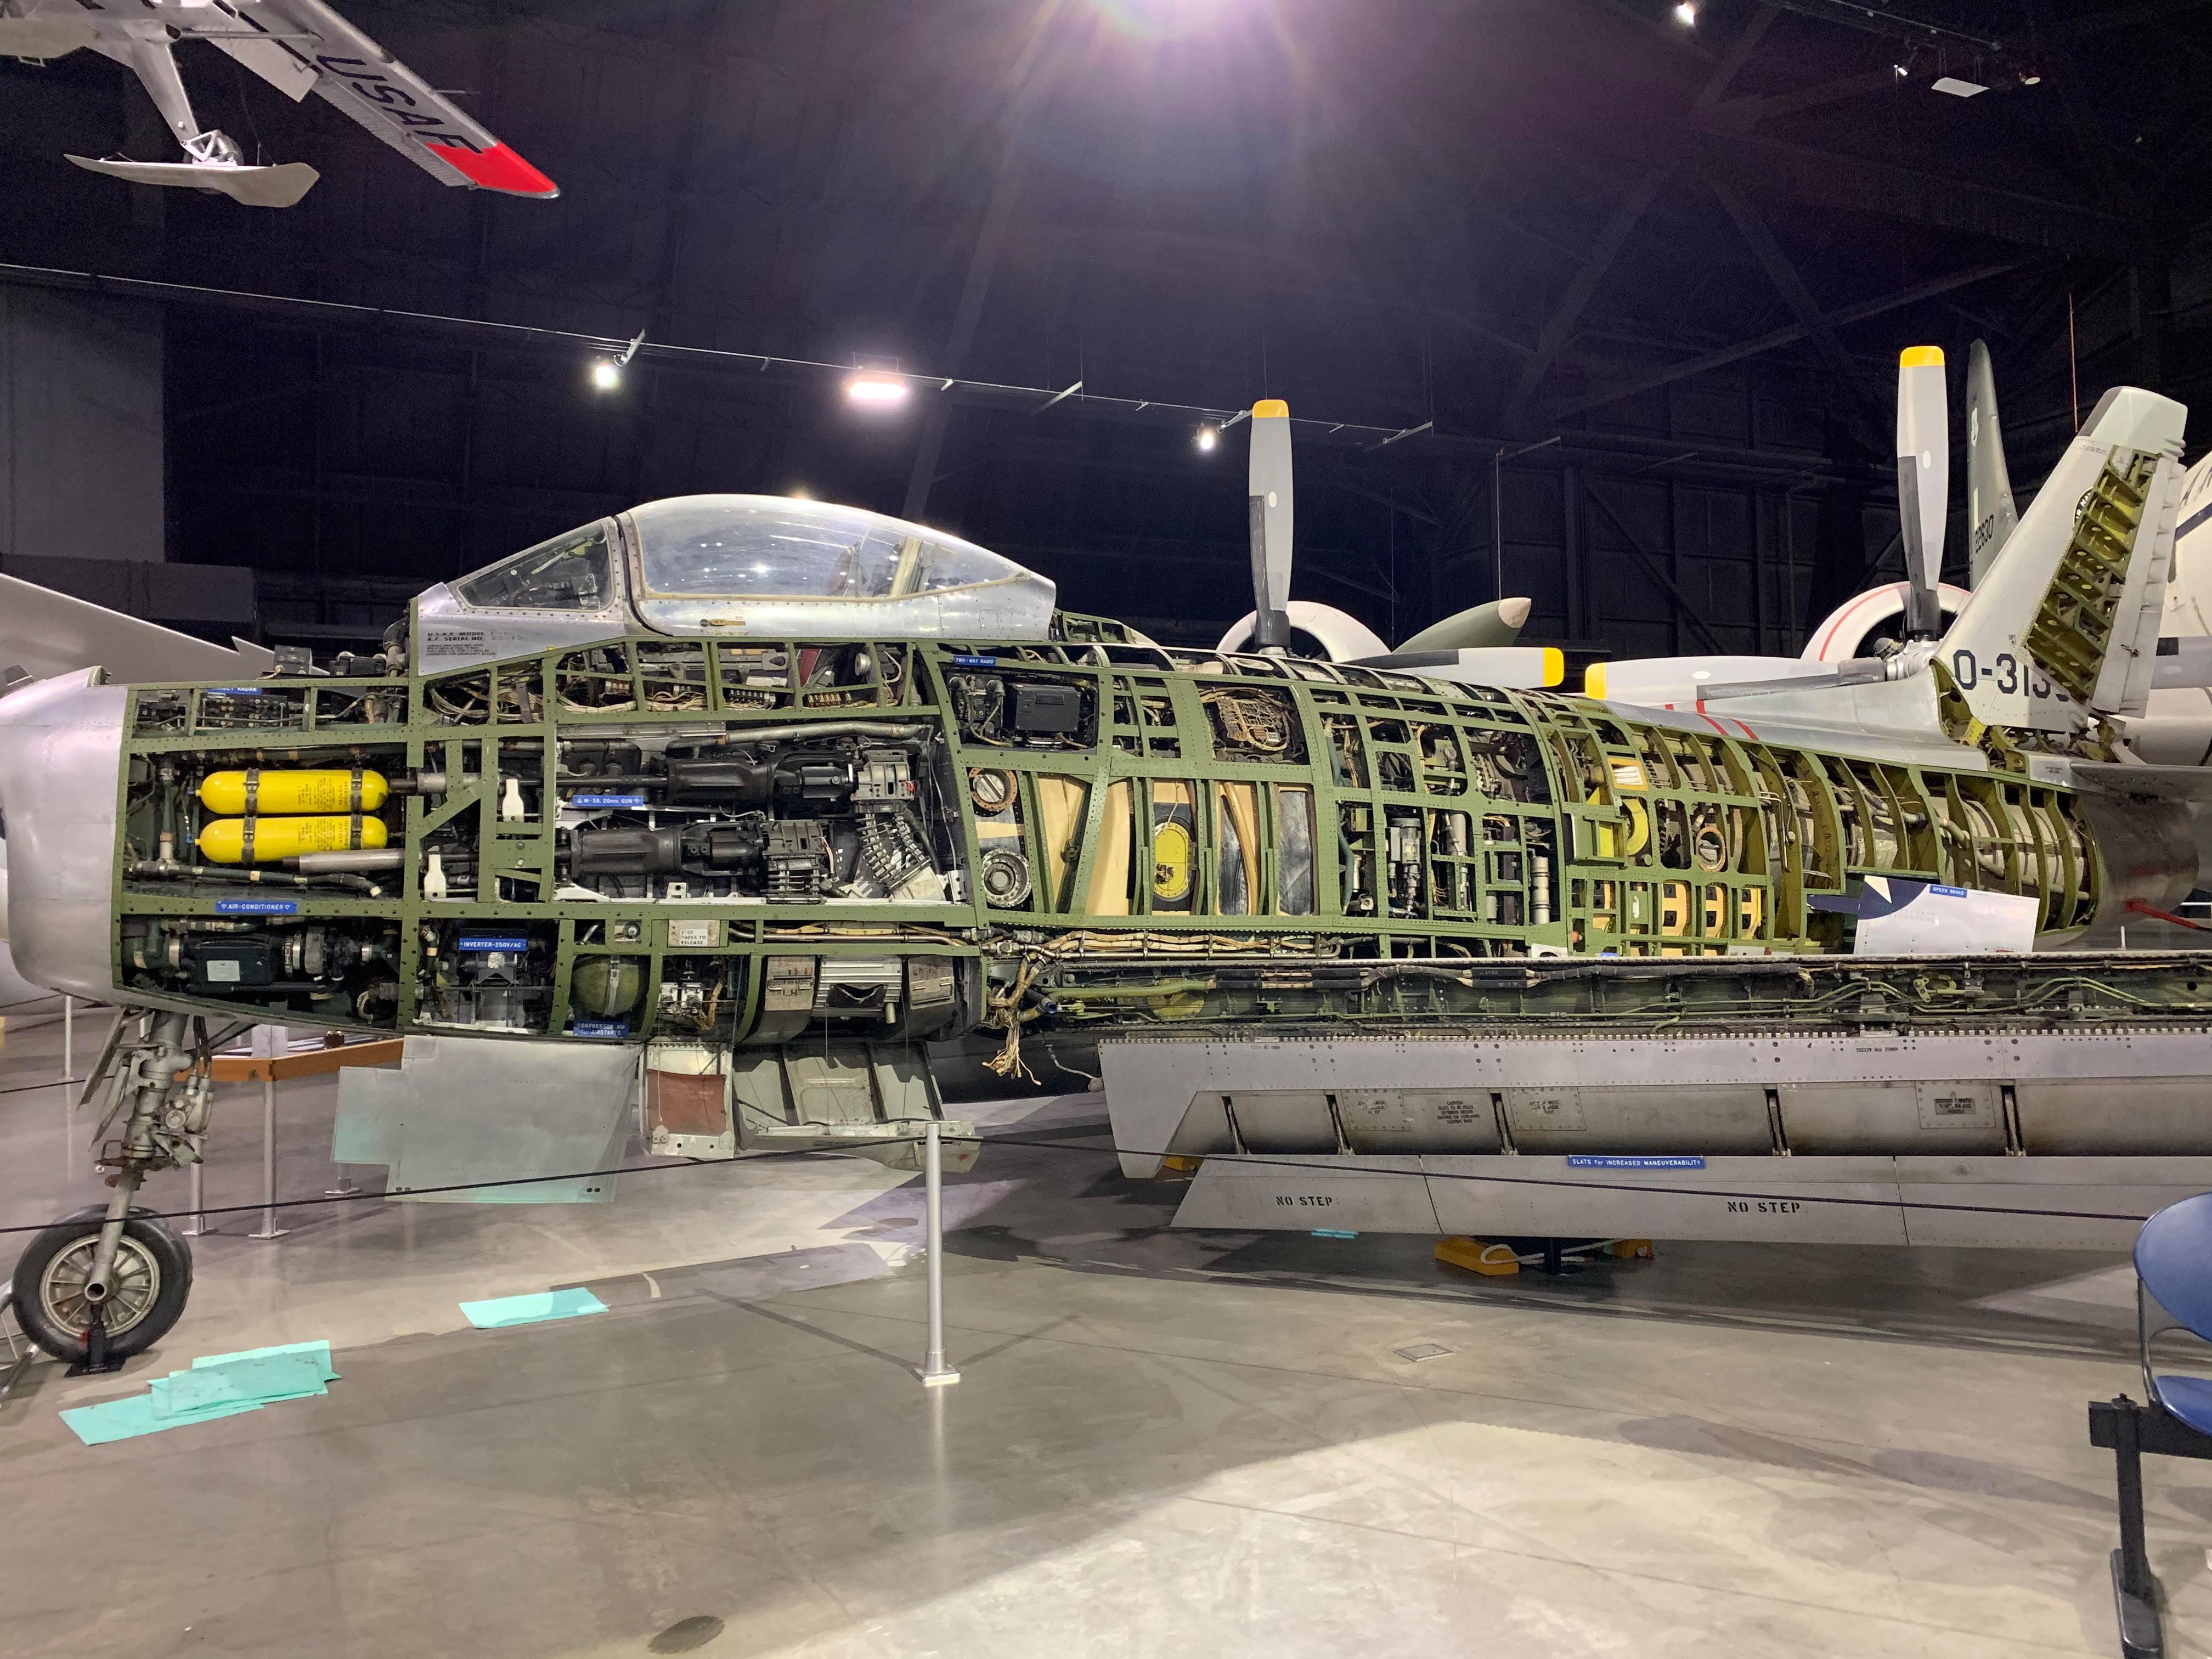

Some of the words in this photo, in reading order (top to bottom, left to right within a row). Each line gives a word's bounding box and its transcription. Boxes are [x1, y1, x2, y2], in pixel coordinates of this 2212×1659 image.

[316, 55, 483, 154] USAF
[1276, 1196, 1293, 1206] NO
[1299, 1196, 1333, 1206] STEP
[1727, 1201, 1749, 1212] NO
[1757, 1202, 1800, 1213] STEP
